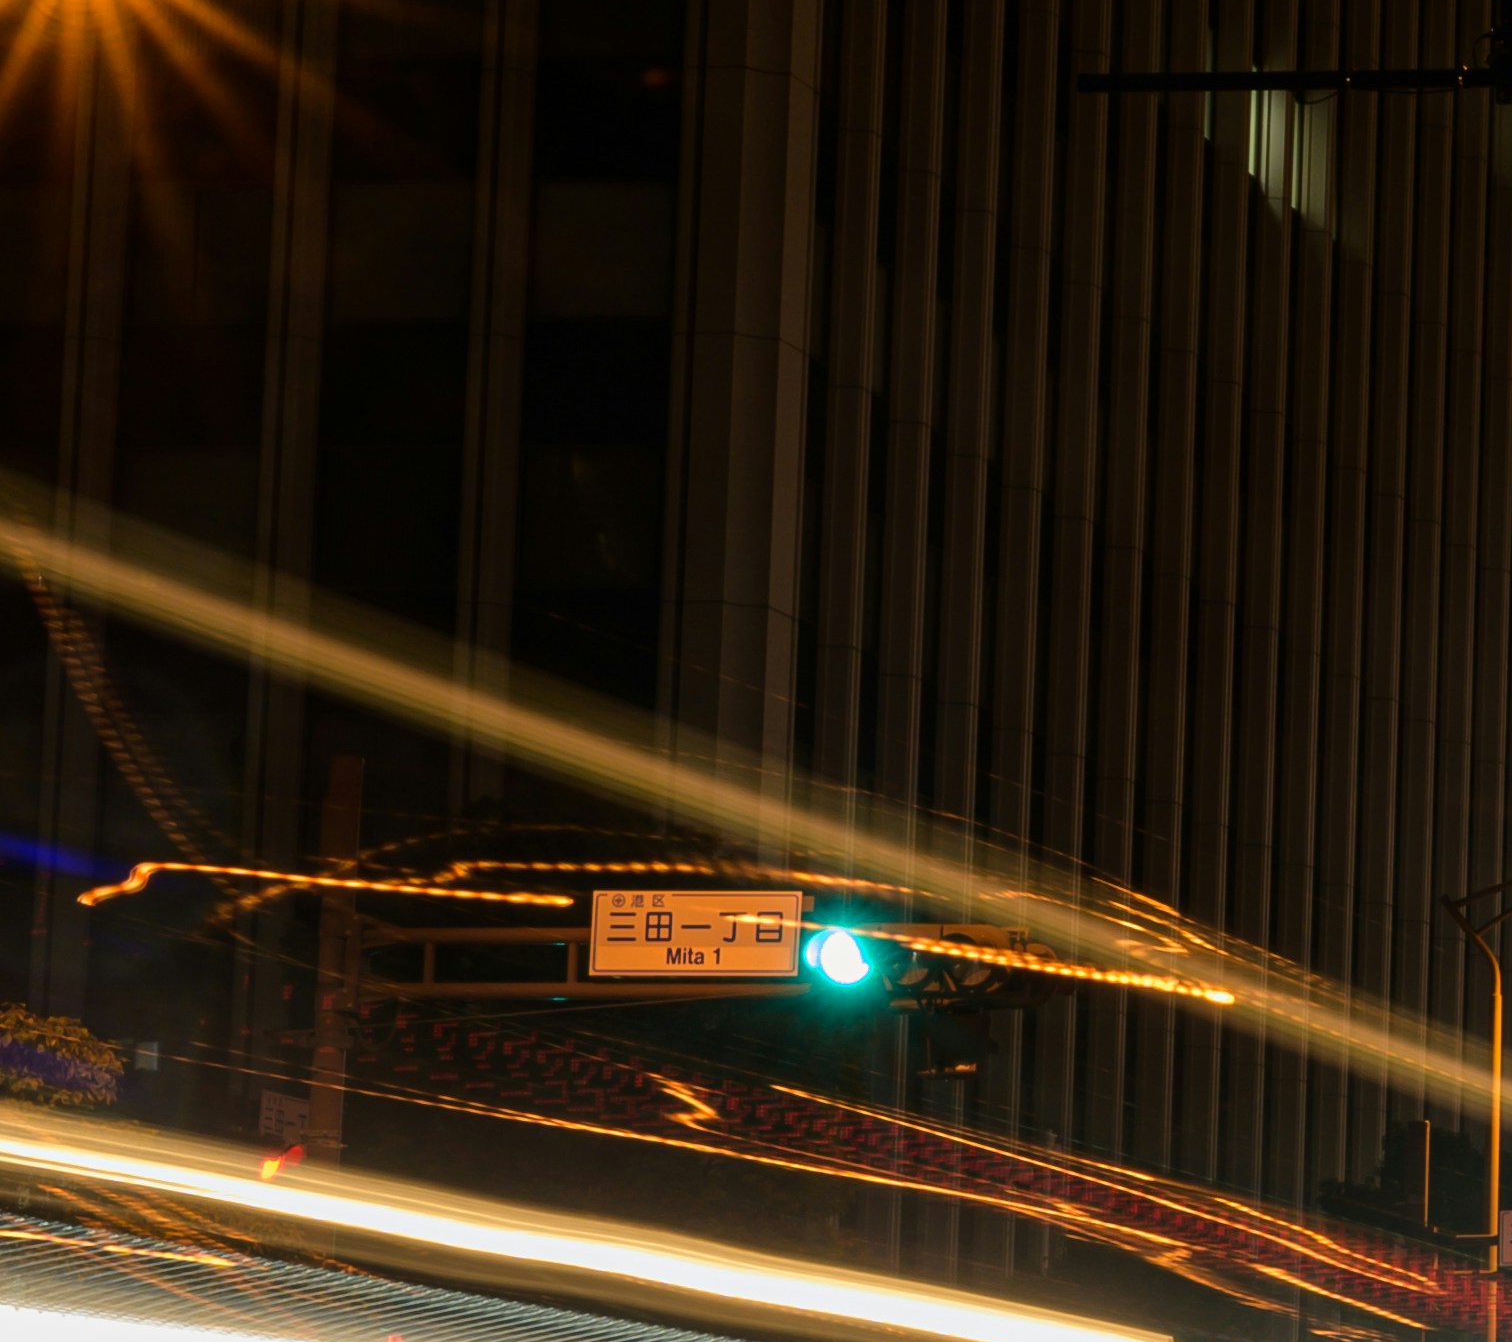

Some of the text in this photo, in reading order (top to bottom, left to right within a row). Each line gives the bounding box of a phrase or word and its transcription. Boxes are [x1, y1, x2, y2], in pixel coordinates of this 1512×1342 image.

[630, 894, 666, 908] 港区
[606, 911, 784, 943] 三田一丁目
[666, 947, 721, 965] Mita 1
